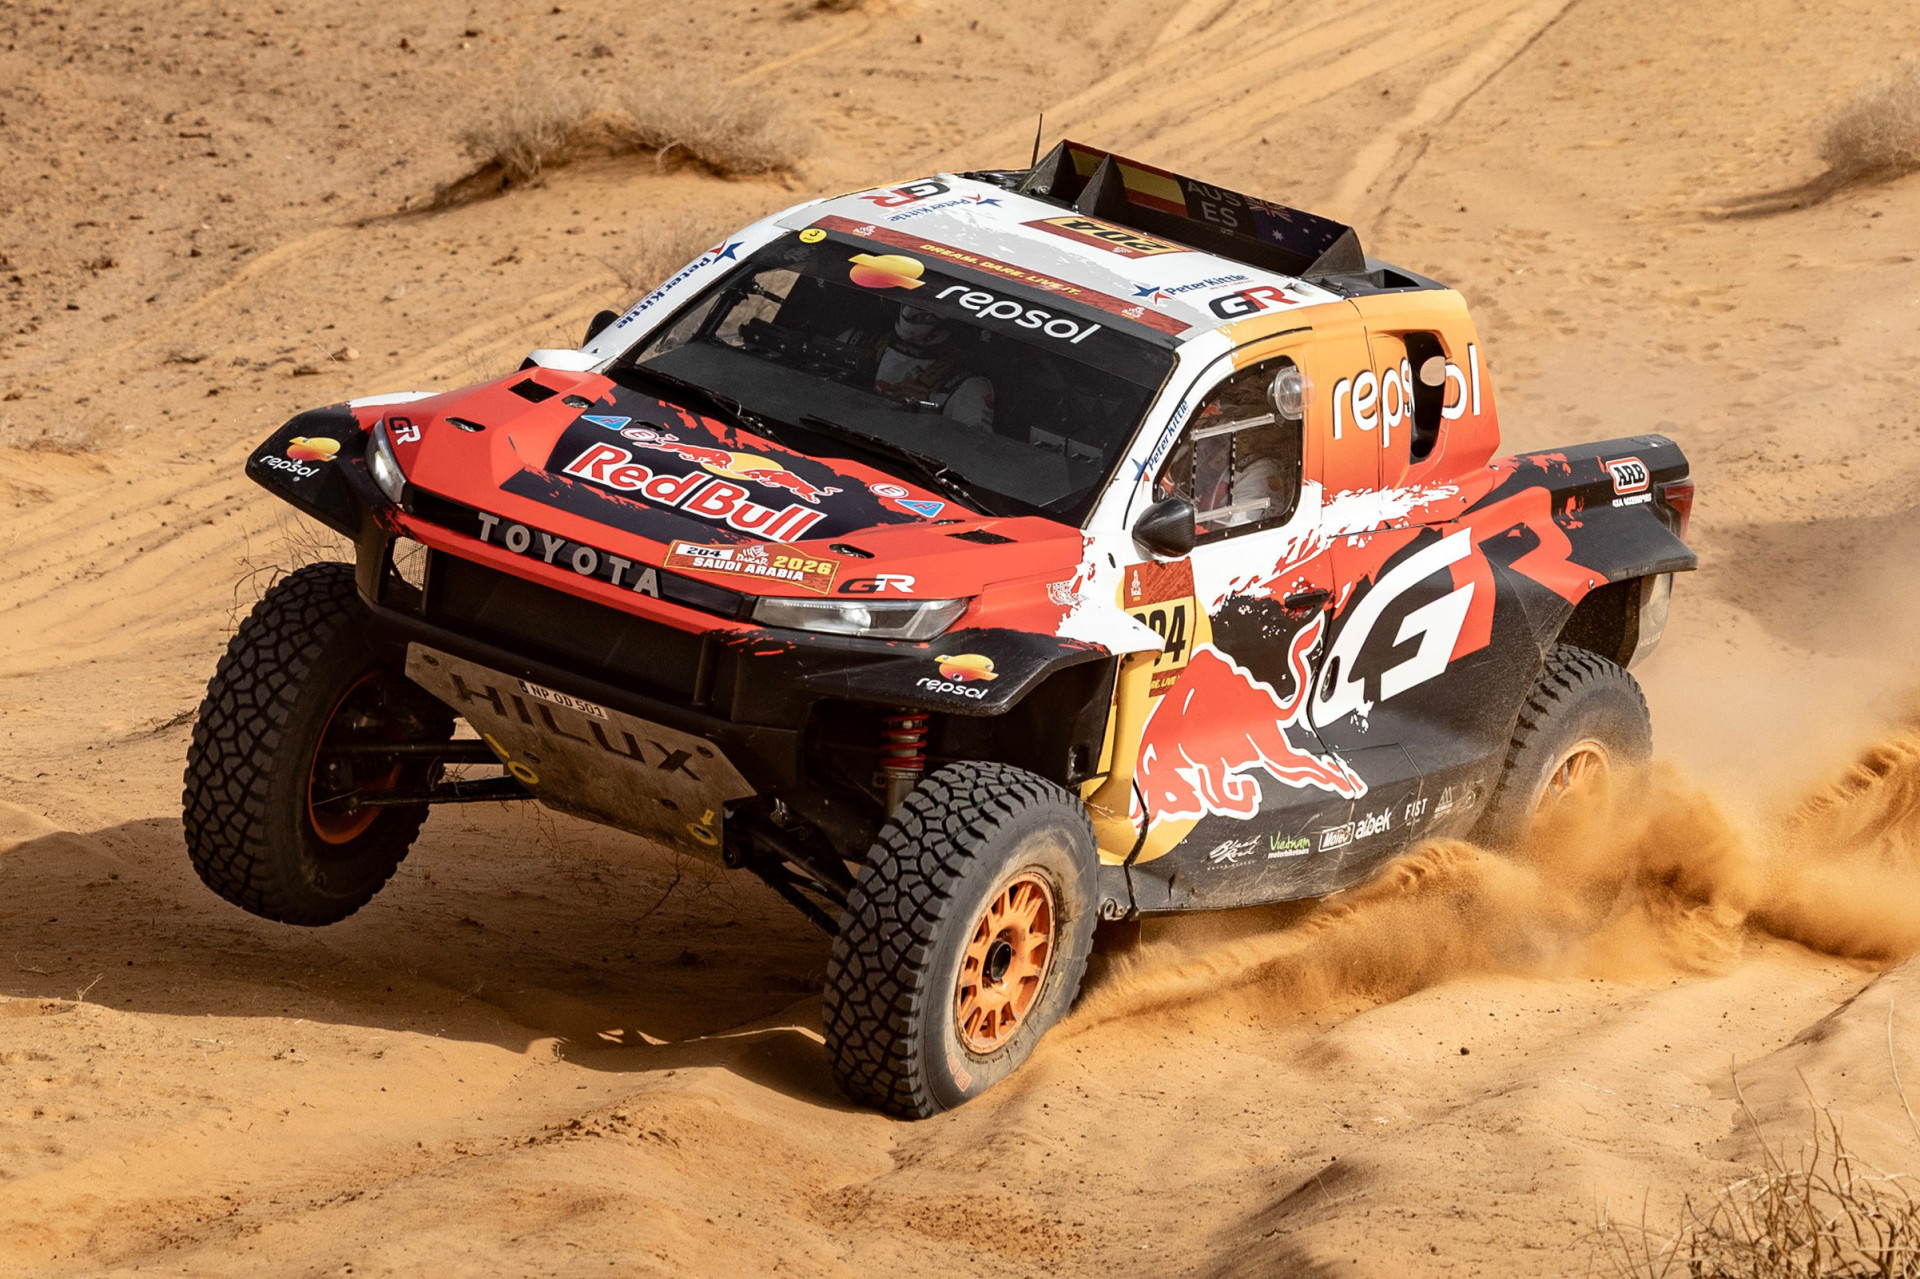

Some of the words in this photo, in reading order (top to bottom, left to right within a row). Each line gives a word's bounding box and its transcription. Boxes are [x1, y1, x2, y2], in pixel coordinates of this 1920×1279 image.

[1187, 181, 1241, 208] AUS
[1201, 201, 1239, 228] ES
[1061, 219, 1170, 251] 204
[920, 244, 977, 264] DREAM.
[979, 261, 1025, 278] DARE.
[1026, 274, 1063, 290] LIVE
[935, 285, 1101, 344] repsol
[1208, 285, 1300, 320] GR
[388, 416, 421, 445] GR
[259, 454, 320, 478] repsol
[1613, 463, 1646, 487] ARB
[477, 511, 659, 598] TOYOTA
[686, 546, 722, 558] 204
[772, 555, 832, 575] 2026
[692, 557, 741, 572] SAUDI
[745, 565, 804, 581] ARABIA
[837, 573, 916, 594] GR
[1133, 604, 1187, 667] 04
[530, 684, 550, 699] NP
[575, 701, 605, 718] 501
[916, 678, 989, 700] repsol
[450, 672, 702, 782] HILUX
[1404, 798, 1428, 820] FIST
[1269, 831, 1311, 851] Vietnam
